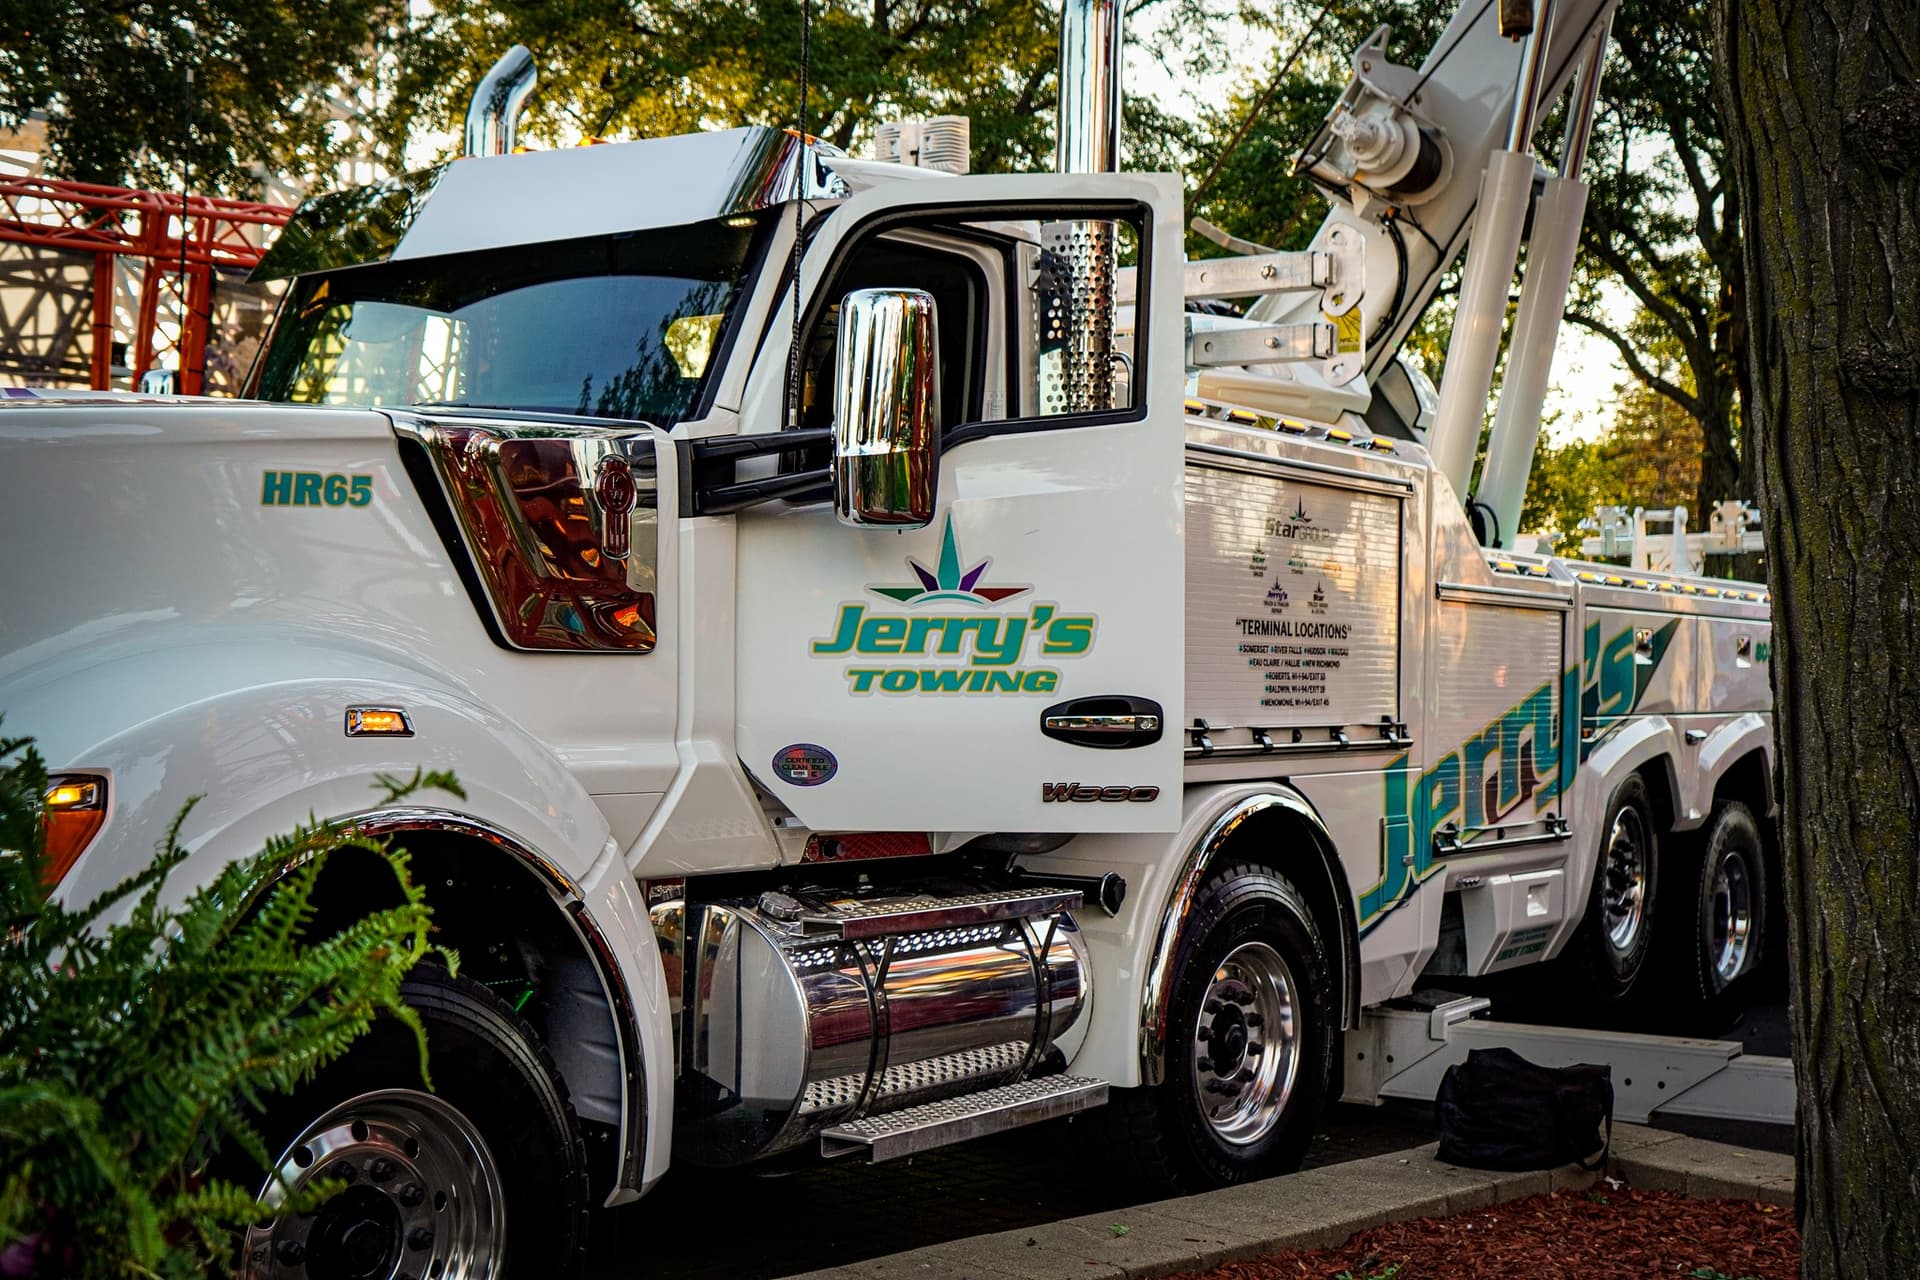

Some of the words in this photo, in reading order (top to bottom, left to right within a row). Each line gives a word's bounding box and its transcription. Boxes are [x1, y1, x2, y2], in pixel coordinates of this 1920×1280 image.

[262, 471, 373, 507] HR65
[812, 604, 1094, 665] Jerry's
[847, 668, 1059, 693] TOWING
[1358, 618, 1635, 928] Jerry's
[1042, 782, 1160, 803] W990
